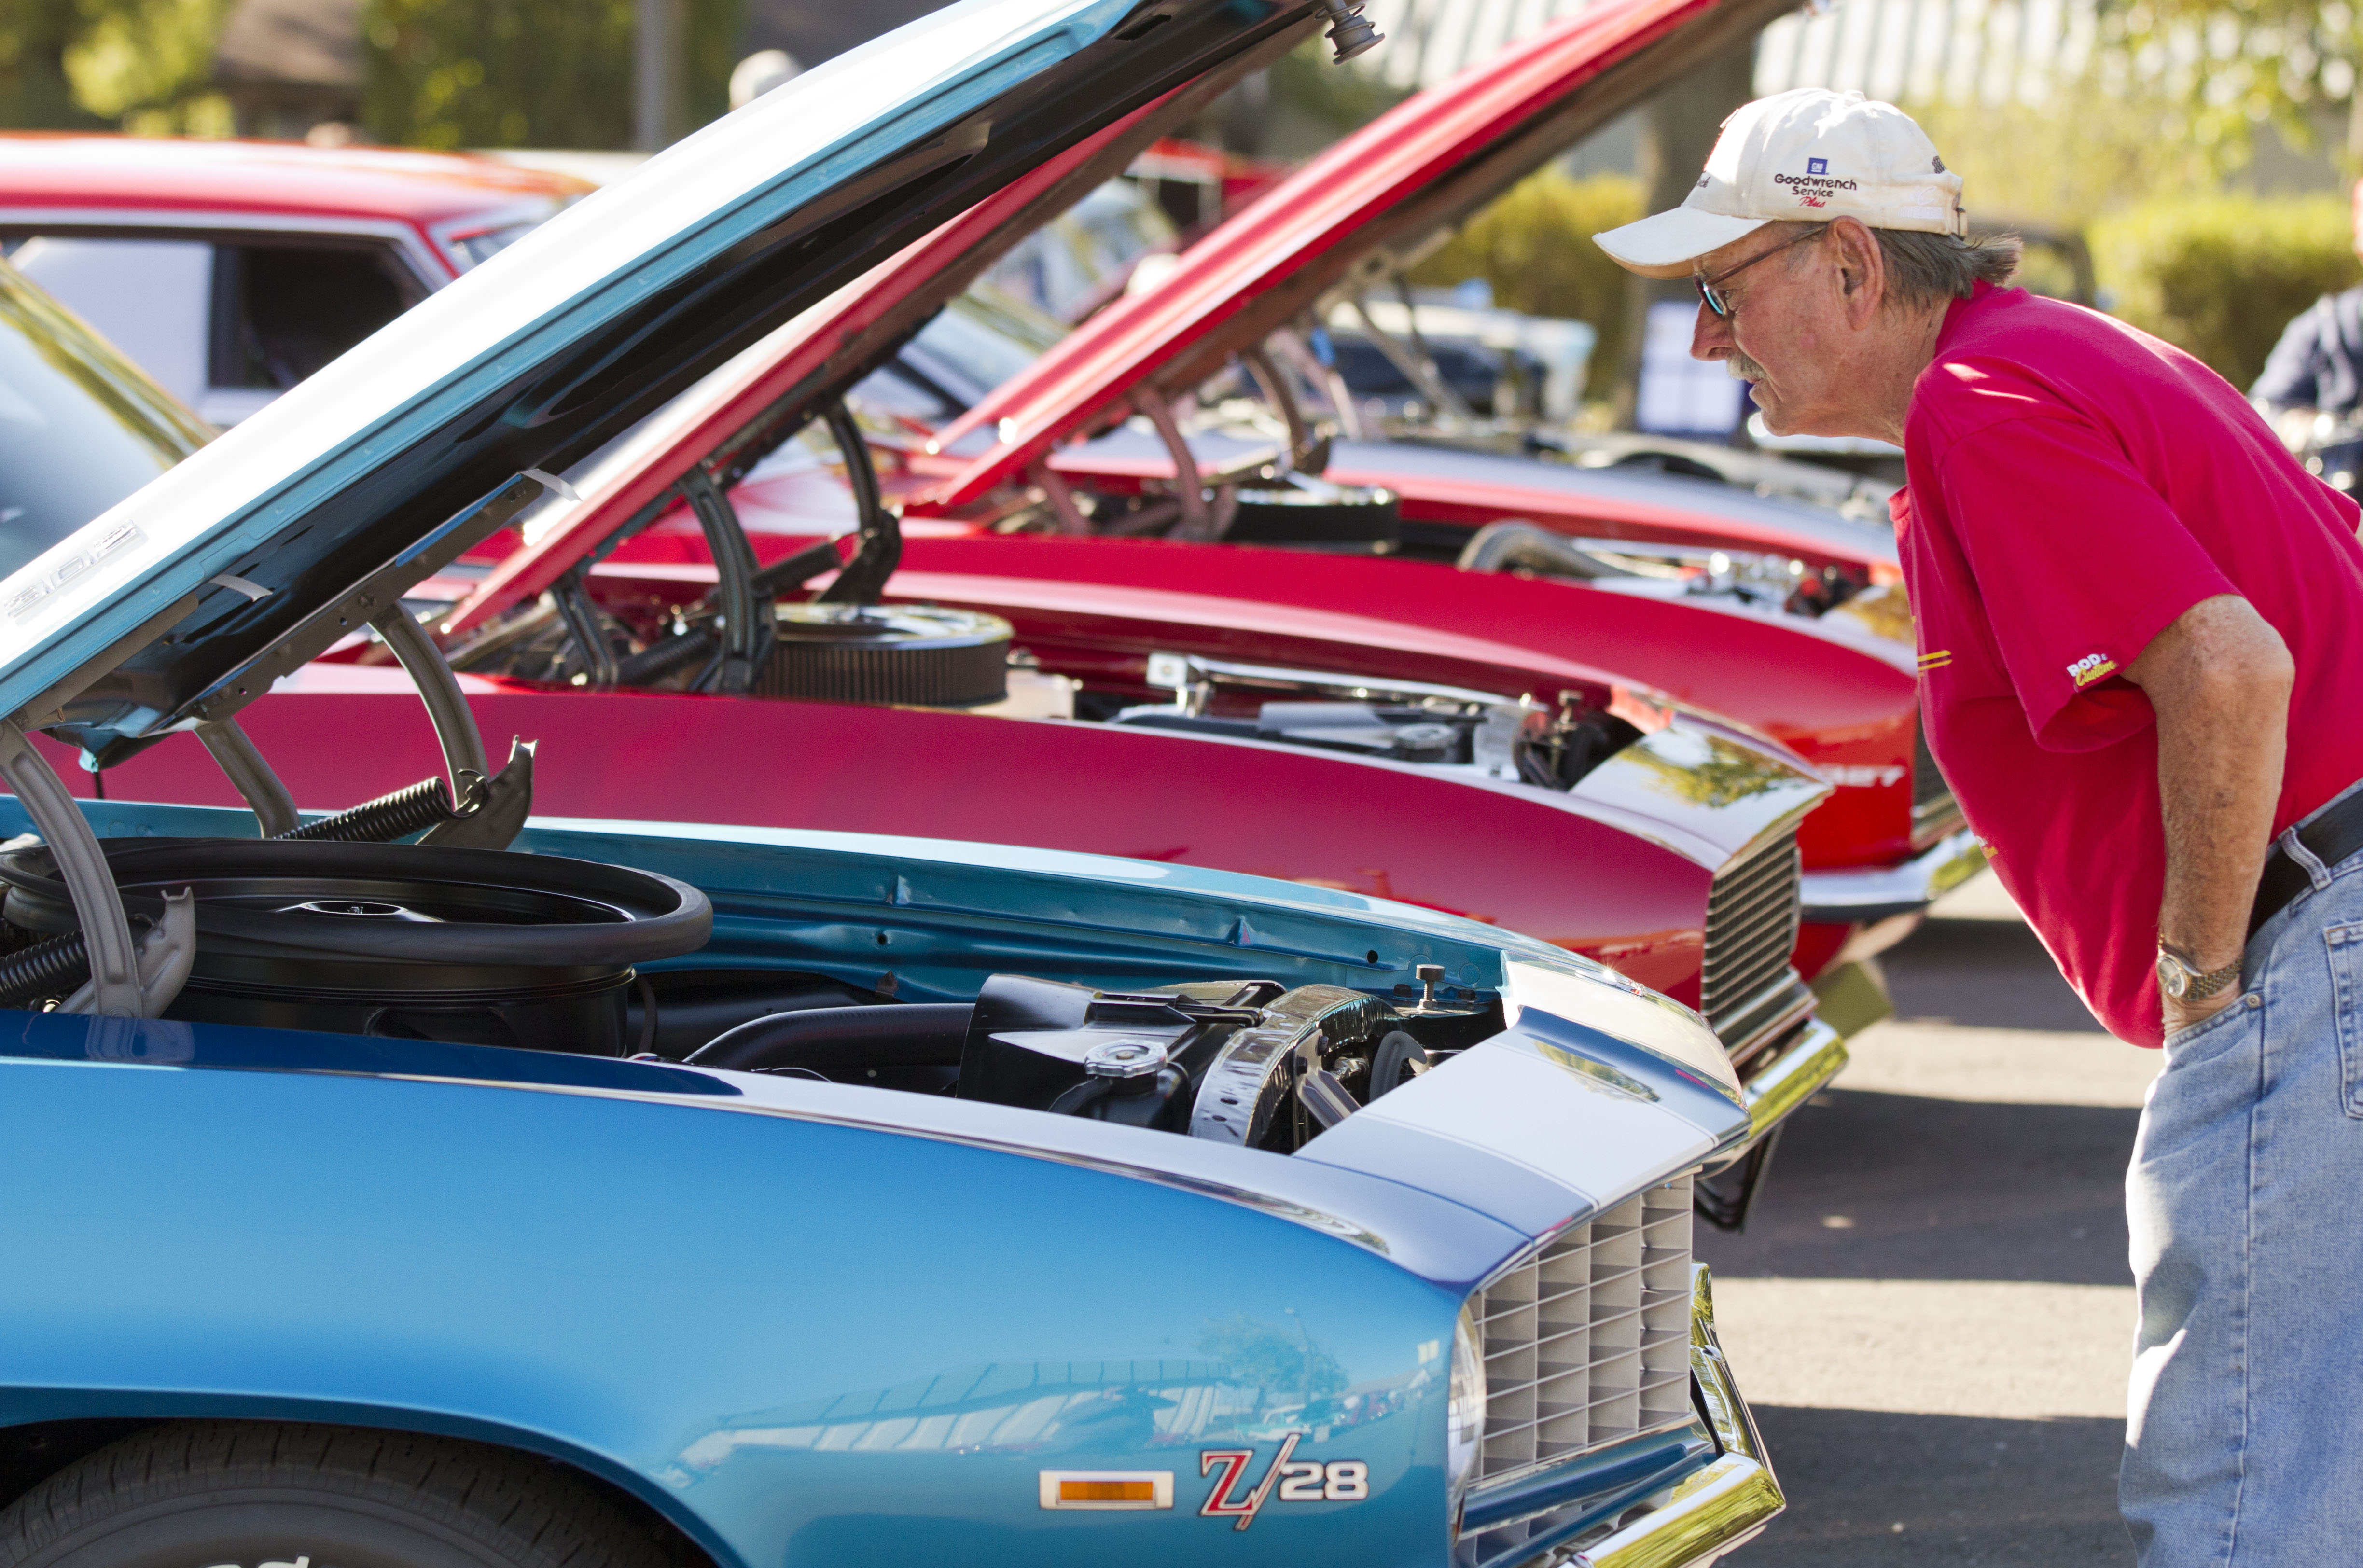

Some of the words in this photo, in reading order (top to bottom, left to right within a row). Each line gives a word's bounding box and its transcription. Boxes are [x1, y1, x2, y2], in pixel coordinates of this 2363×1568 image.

[1774, 173, 1857, 191] Goodwrench
[1792, 186, 1834, 197] Service
[1799, 196, 1826, 208] Plus
[1199, 1432, 1369, 1531] Z/28
